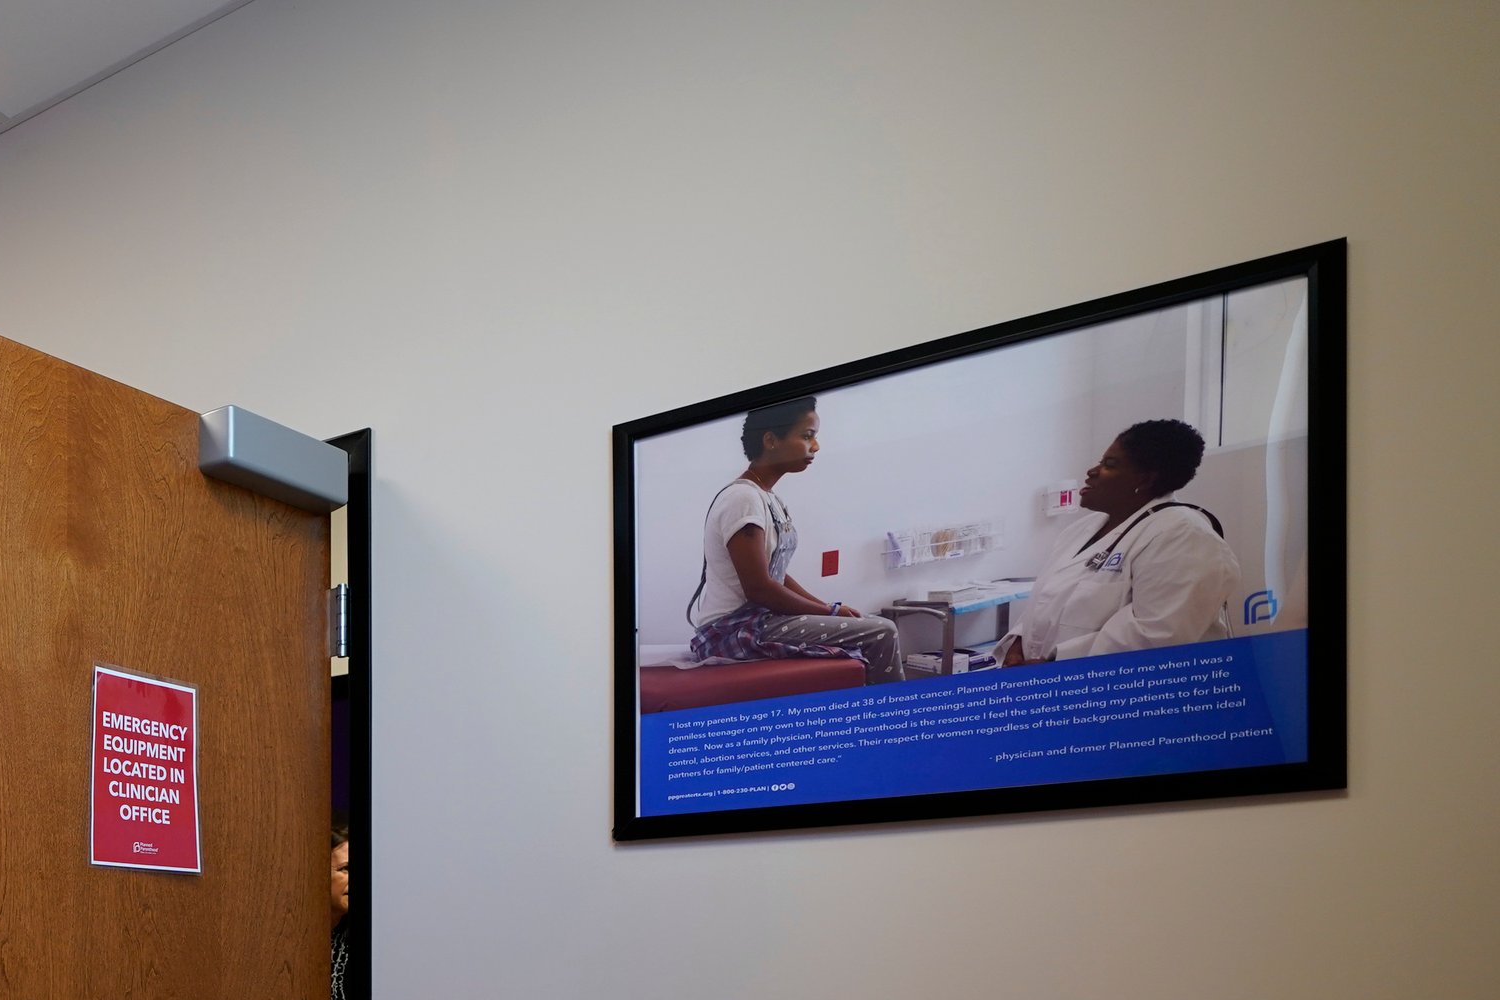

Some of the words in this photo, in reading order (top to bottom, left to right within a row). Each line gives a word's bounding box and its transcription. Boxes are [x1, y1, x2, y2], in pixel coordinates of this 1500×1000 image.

[668, 732, 706, 743] penniless
[707, 728, 745, 737] teenager
[806, 717, 826, 726] help
[845, 714, 860, 723] get
[862, 709, 910, 719] life-saving
[912, 702, 965, 713] screenings
[966, 697, 986, 707] and
[988, 695, 1012, 704] birth
[1015, 690, 1052, 701] control
[1060, 685, 1088, 696] need
[1113, 679, 1144, 690] could
[1147, 676, 1187, 688] pursue
[1190, 674, 1208, 682] my
[1211, 669, 1229, 678] life
[706, 716, 738, 727] parents
[739, 714, 750, 722] by
[770, 709, 783, 717] 17.
[787, 707, 801, 716] My
[803, 705, 826, 713] mom
[828, 701, 849, 710] died
[862, 697, 874, 706] 38
[876, 695, 886, 704] of
[888, 693, 918, 703] breast
[920, 690, 954, 699] cancer.
[956, 682, 998, 694] Planned
[1000, 674, 1061, 689] Parenthood
[1063, 673, 1084, 681] was
[1087, 670, 1116, 678] there
[1118, 666, 1134, 674] for
[1158, 661, 1190, 670] when
[1199, 657, 1223, 665] was
[103, 711, 188, 741] EMERGENCY
[668, 746, 700, 754] dreams.
[742, 737, 768, 746] family
[770, 733, 813, 744] physician,
[814, 727, 851, 737] Planned
[853, 720, 907, 733] Parenthood
[919, 718, 935, 726] the
[937, 714, 980, 724] resource
[988, 709, 1008, 719] feel
[1010, 708, 1027, 716] the
[1029, 704, 1060, 714] safest
[1062, 700, 1106, 710] sending
[1109, 698, 1126, 706] my
[1129, 692, 1175, 705] patients
[1193, 687, 1209, 696] for
[1213, 683, 1241, 694] birth
[668, 757, 698, 767] control,
[699, 754, 735, 763] abortion
[736, 751, 772, 759] services,
[773, 746, 790, 755] and
[792, 745, 816, 753] other
[818, 742, 856, 751] services.
[857, 738, 881, 746] Their
[883, 734, 918, 744] respect
[920, 732, 934, 740] for
[936, 729, 973, 738] women
[976, 723, 1029, 735] regardless
[1031, 719, 1043, 728] of
[1045, 717, 1070, 727] their
[1072, 709, 1139, 724] background
[1142, 706, 1179, 716] makes
[1182, 703, 1213, 712] them
[1216, 698, 1246, 709] ideal
[104, 734, 186, 762] EQUIPMENT
[995, 750, 1043, 762] physician
[1046, 746, 1066, 756] and
[1069, 744, 1106, 753] former
[1109, 738, 1155, 749] Planned
[1158, 731, 1226, 744] Parenthood
[1230, 728, 1272, 740] patient
[104, 757, 166, 781] LOCATED
[170, 768, 184, 784] IN
[668, 771, 701, 780] partners
[716, 763, 774, 774] family/patient
[775, 757, 814, 768] centered
[109, 781, 180, 804] CLINICIAN
[119, 804, 170, 824] OFFICE
